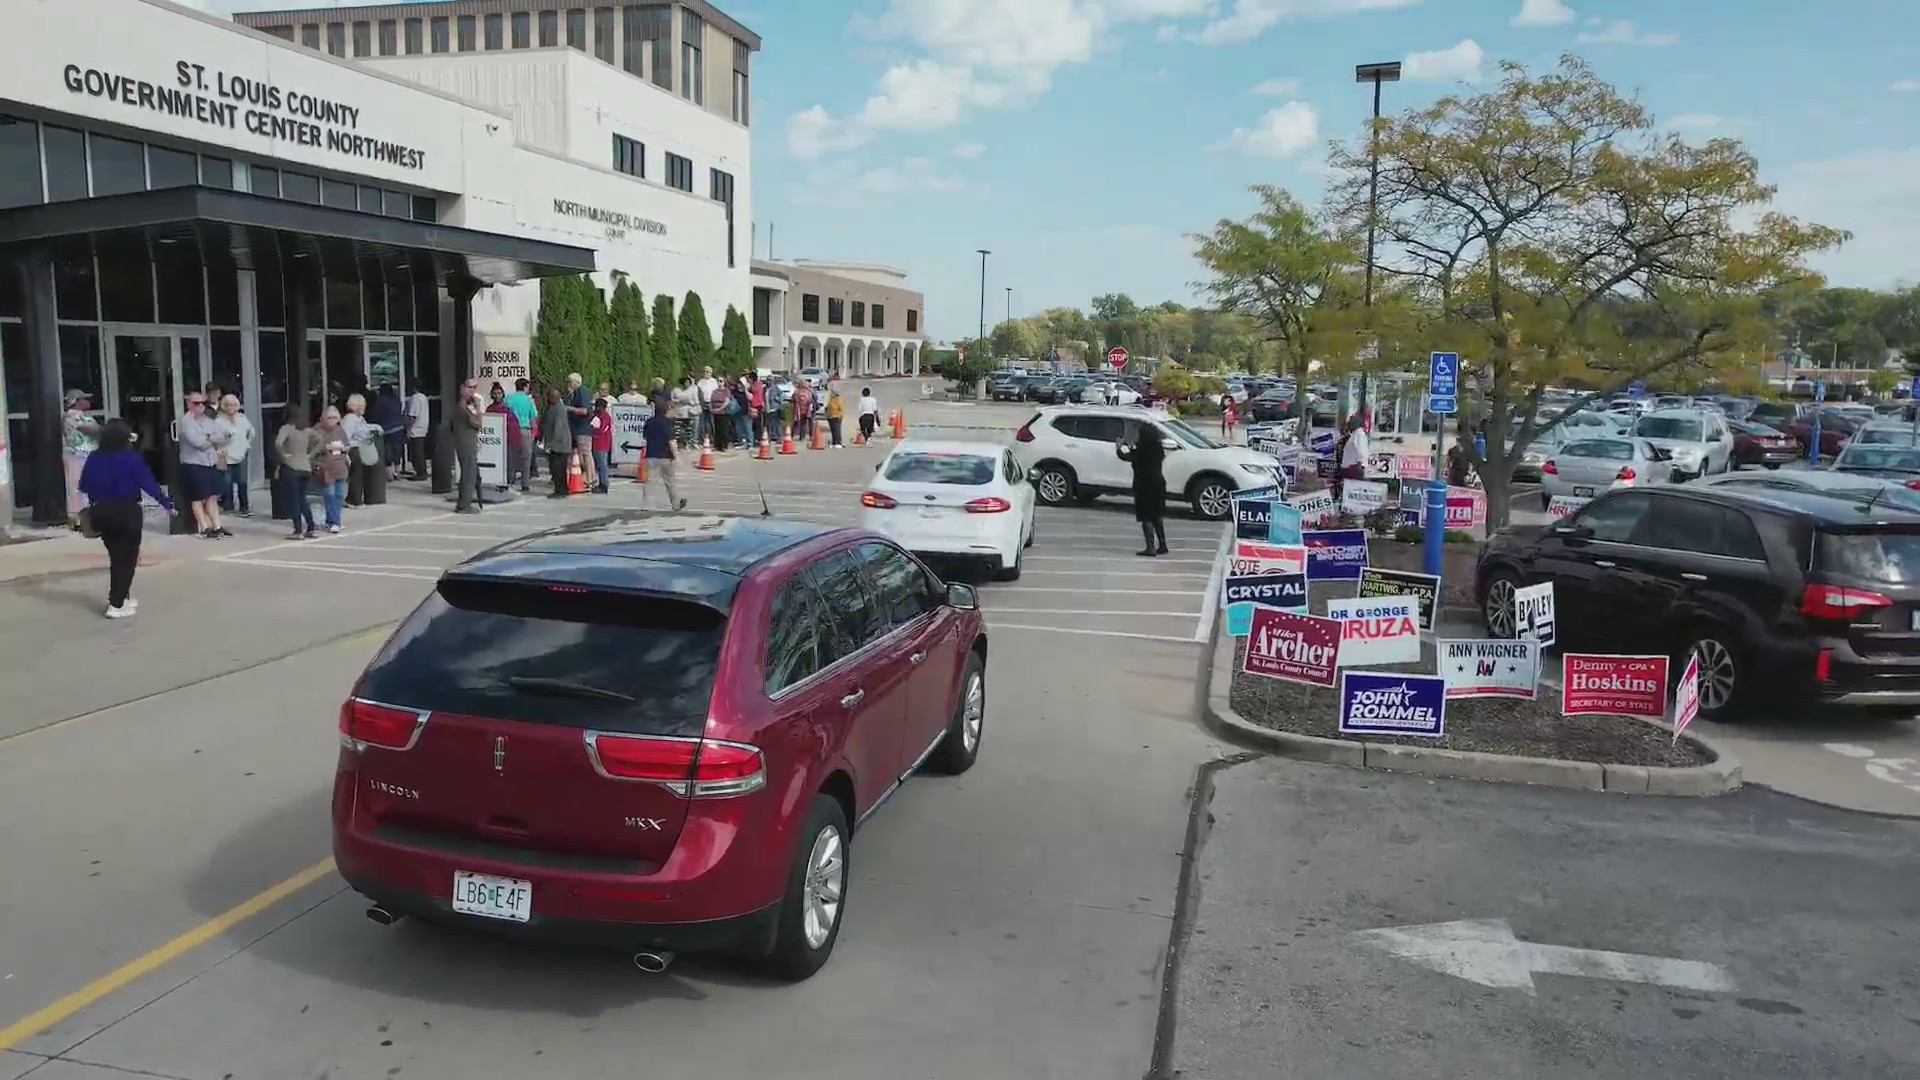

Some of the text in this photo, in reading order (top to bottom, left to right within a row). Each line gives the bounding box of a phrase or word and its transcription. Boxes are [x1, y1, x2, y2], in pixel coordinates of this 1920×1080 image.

[176, 60, 360, 130] ST. LOUIS COUNTY
[64, 64, 426, 170] GOVERNMENT CENTER NORTHWEST
[553, 198, 667, 236] NORTH MUNICIPAL DIVISION
[484, 350, 520, 363] MISSOURI
[1110, 353, 1127, 362] STOP
[479, 366, 526, 378] JOB CENTER
[1298, 497, 1332, 513] ONES
[1230, 558, 1261, 572] VOTE
[1228, 583, 1305, 599] CRYSTAL
[1331, 606, 1409, 620] DR GEORGE
[1272, 628, 1297, 639] Mike
[1250, 625, 1336, 667] Archer
[1448, 644, 1528, 659] ANN WAGNER
[1262, 660, 1280, 670] Louis
[1280, 662, 1302, 675] County
[1303, 667, 1328, 679] Council
[1573, 660, 1648, 673] Denny CPA
[1571, 674, 1657, 693] Hoskins
[1351, 690, 1403, 706] JOHN
[1570, 700, 1613, 708] SECRETARY
[1628, 702, 1653, 710] STATE
[1349, 703, 1437, 721] ROMMEL
[370, 779, 419, 800] LINCOLN
[624, 817, 666, 831] MKX
[456, 879, 527, 911] LB6 E4F
